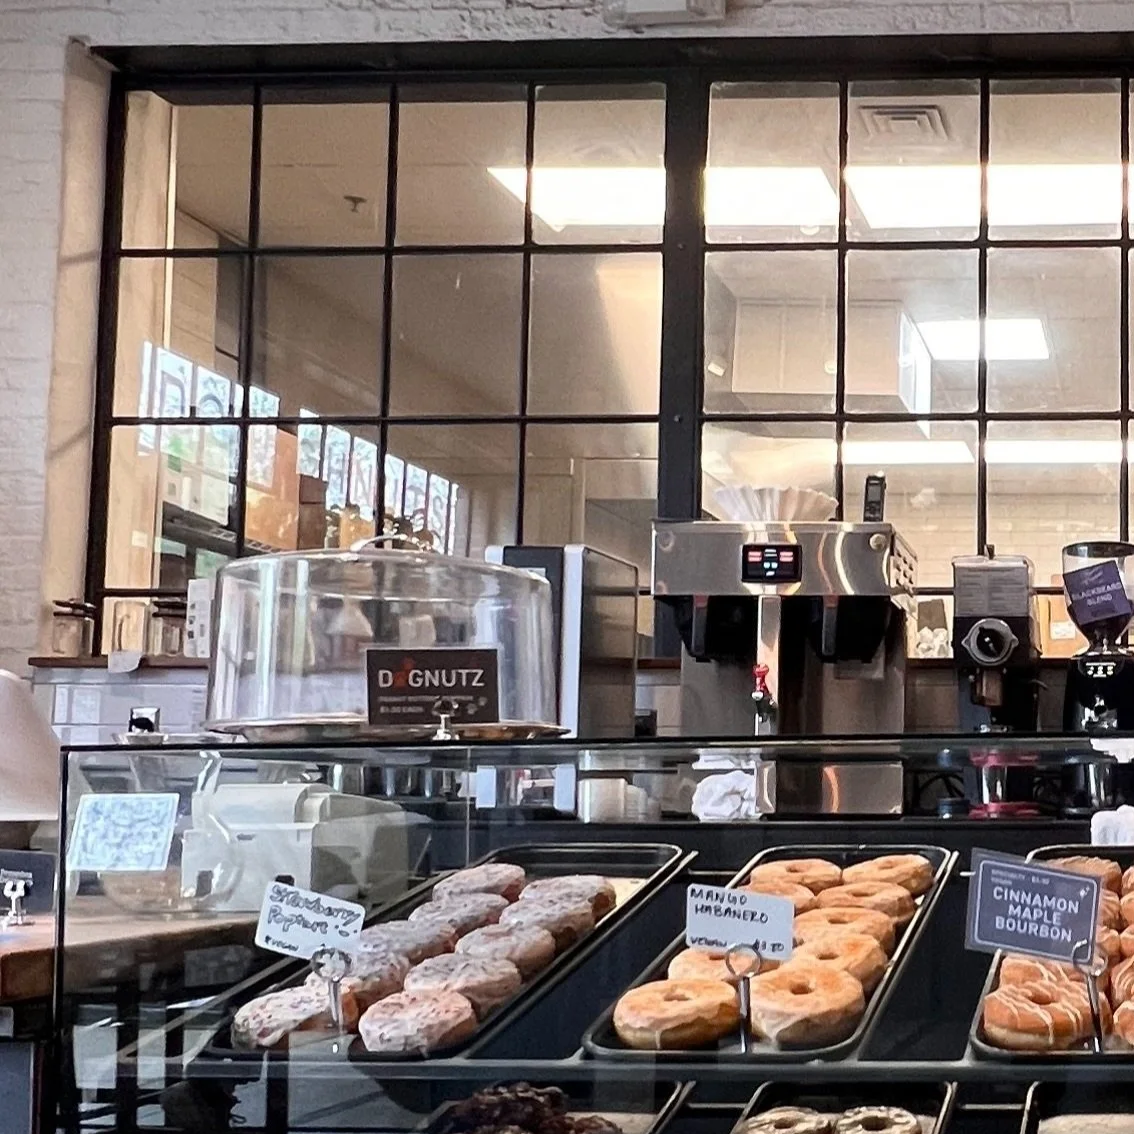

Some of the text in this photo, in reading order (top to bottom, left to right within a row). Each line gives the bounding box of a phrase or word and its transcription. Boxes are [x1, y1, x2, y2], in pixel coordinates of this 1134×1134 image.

[690, 887, 748, 905] MANGO
[993, 886, 1080, 914] CINNAMON
[694, 903, 769, 924] HABANERO
[1008, 904, 1062, 926] MAPLE
[995, 915, 1073, 943] BOURBON
